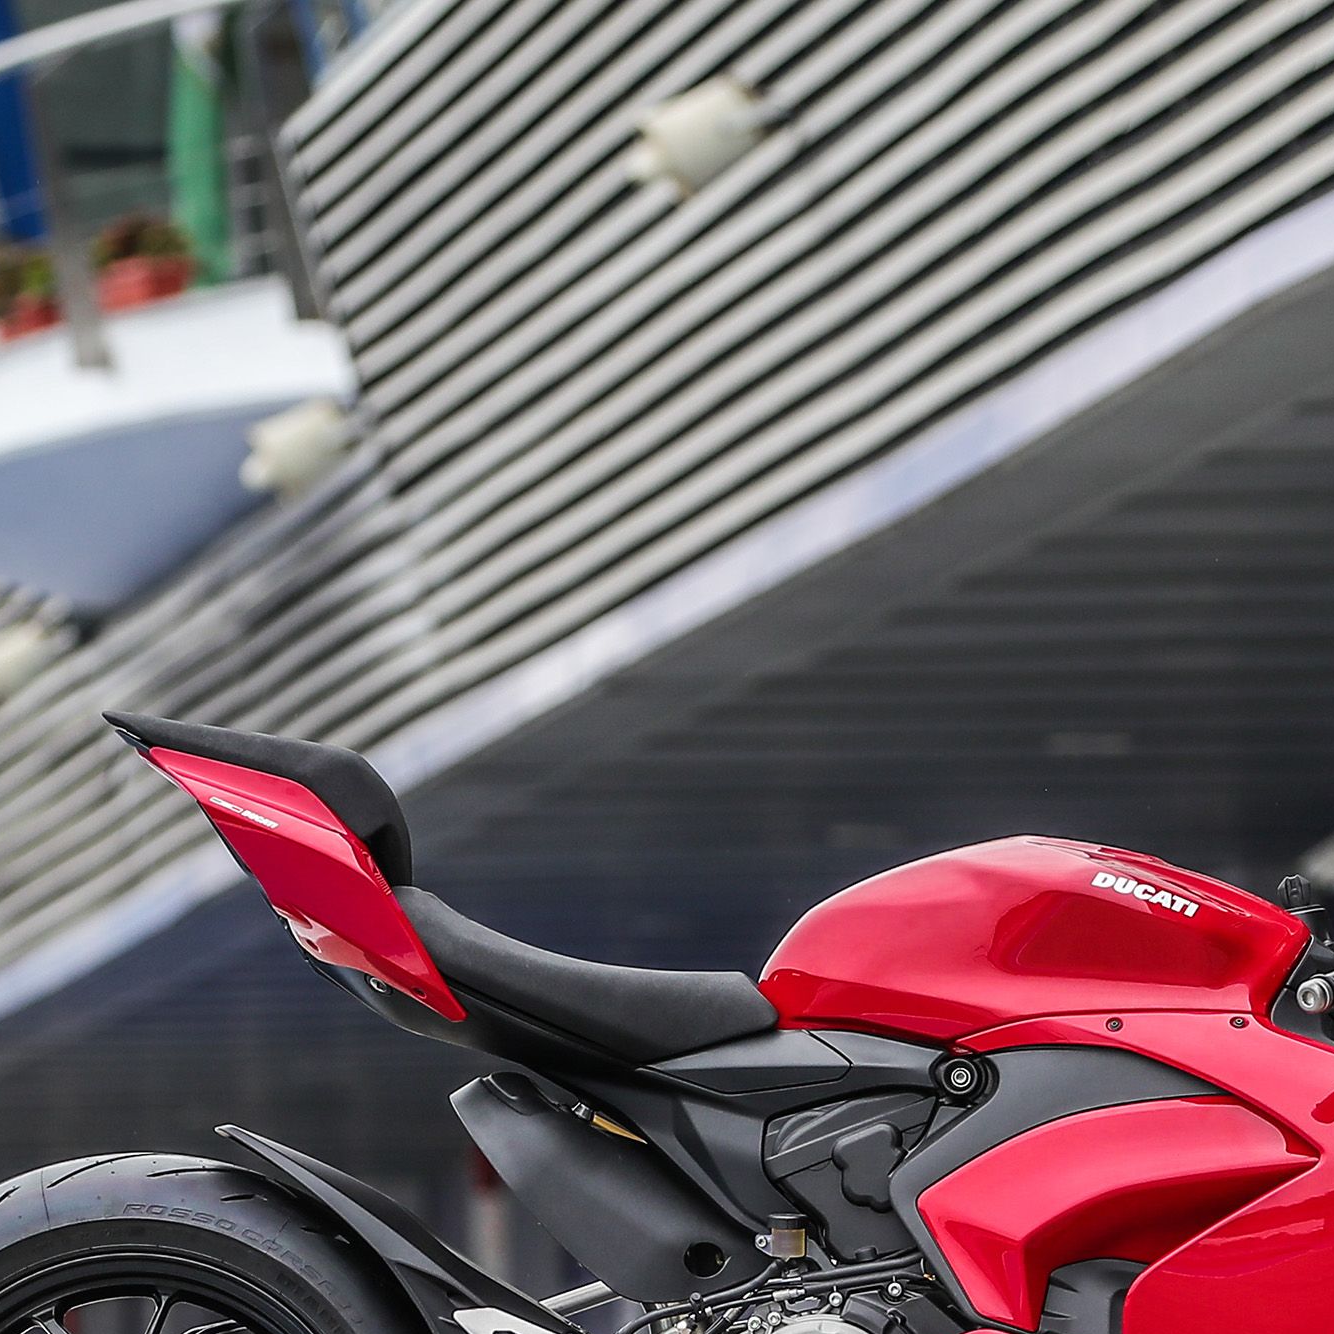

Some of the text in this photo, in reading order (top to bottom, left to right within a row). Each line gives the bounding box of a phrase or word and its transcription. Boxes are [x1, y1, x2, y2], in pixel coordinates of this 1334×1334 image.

[1091, 872, 1199, 917] DUCATI
[123, 1203, 235, 1231] ROSSO
[242, 1229, 333, 1297] CORSA
